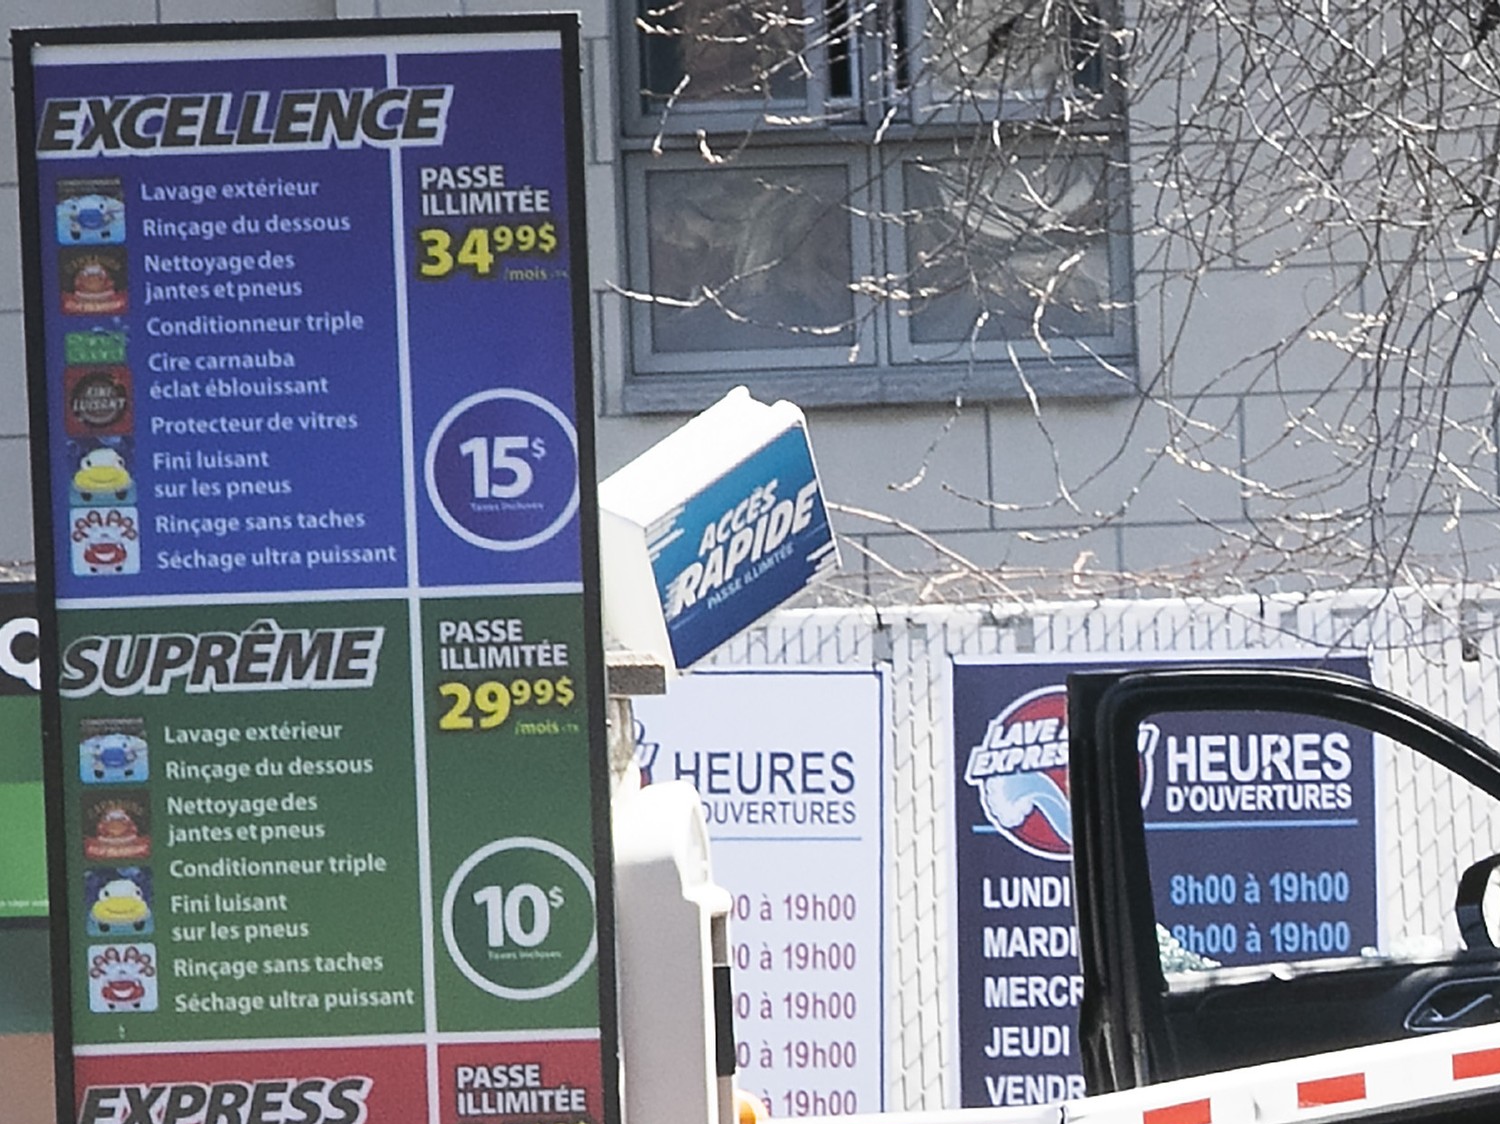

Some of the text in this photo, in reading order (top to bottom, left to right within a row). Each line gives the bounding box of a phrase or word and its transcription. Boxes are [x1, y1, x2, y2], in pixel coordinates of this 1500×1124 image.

[35, 85, 454, 159] EXCELLENCE
[140, 181, 218, 202] Lavage
[222, 177, 320, 198] extérieur
[420, 164, 505, 190] PASSE
[421, 187, 551, 216] ILLIMITÉE
[142, 212, 352, 240] Rinçage du dessous
[144, 252, 254, 275] Nettoyage
[257, 250, 296, 270] des
[144, 278, 303, 304] jantes et pneus
[146, 310, 365, 337] Conditionneur triple
[149, 349, 296, 371] Cire carnauba
[149, 374, 329, 398] éclat éblouissant
[151, 409, 358, 435] Protecteur de vitres
[153, 448, 269, 469] Fini luisant
[154, 476, 292, 499] sur les pneus
[155, 509, 365, 536] Rinçage sans taches
[156, 545, 397, 571] Séchage ultra puissant
[664, 478, 817, 620] RAPIDE
[438, 619, 524, 645] PASSE
[58, 619, 386, 698] SUPRÊME
[439, 640, 569, 670] ILLIMITÉE
[164, 720, 343, 746] Lavage extérieur
[990, 718, 1059, 748] LAVE
[165, 755, 374, 783] Rinçage du dessous
[1166, 732, 1352, 784] HEURES
[674, 751, 855, 794] HEURES
[167, 795, 277, 818] Nettoyage
[280, 792, 319, 813] des
[1166, 783, 1352, 812] D'OUVERTURES
[167, 821, 326, 846] jantes et pneus
[169, 854, 388, 880] Conditionneur triple
[983, 877, 1070, 907] LUNDI
[1171, 872, 1350, 905] 8h00 à 19h00
[170, 893, 288, 913] Fini luisant
[759, 895, 772, 921] à
[783, 895, 856, 921] 19h00
[171, 919, 309, 944] sur les pneus
[984, 926, 1076, 957] MARDI
[1174, 922, 1350, 954] 8h00 à 19h00
[172, 952, 384, 980] Rinçage sans taches
[759, 945, 772, 970] à
[783, 945, 856, 970] 19h00
[174, 987, 416, 1015] Séchage ultra puissant
[759, 993, 772, 1019] à
[783, 993, 856, 1019] 19h00
[985, 1026, 1070, 1056] JEUDI
[759, 1043, 772, 1068] à
[783, 1043, 856, 1068] 19h00
[456, 1064, 540, 1089] PASSE
[457, 1084, 586, 1116] ILLIMITÉE
[783, 1090, 856, 1117] 19h00
